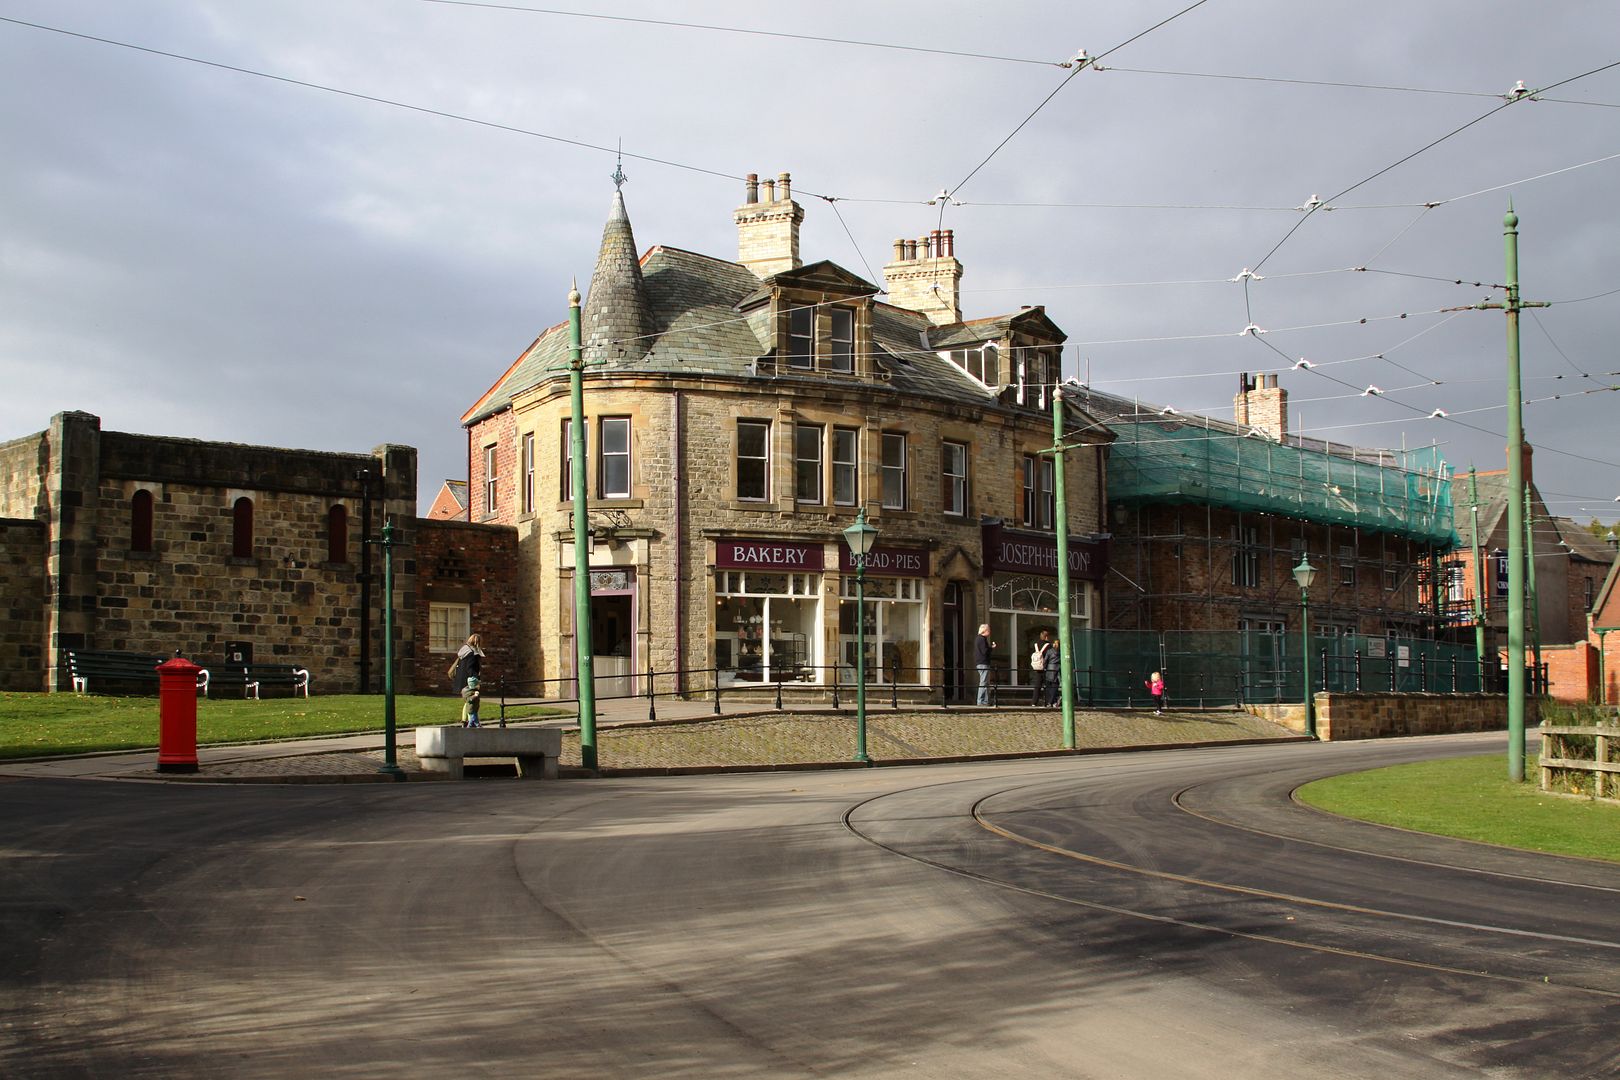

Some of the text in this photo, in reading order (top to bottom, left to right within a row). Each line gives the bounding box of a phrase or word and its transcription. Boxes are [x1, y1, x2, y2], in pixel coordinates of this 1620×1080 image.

[733, 546, 808, 564] BAKERY
[896, 554, 921, 570] PIES
[998, 542, 1089, 571] JOSEPH HERON
